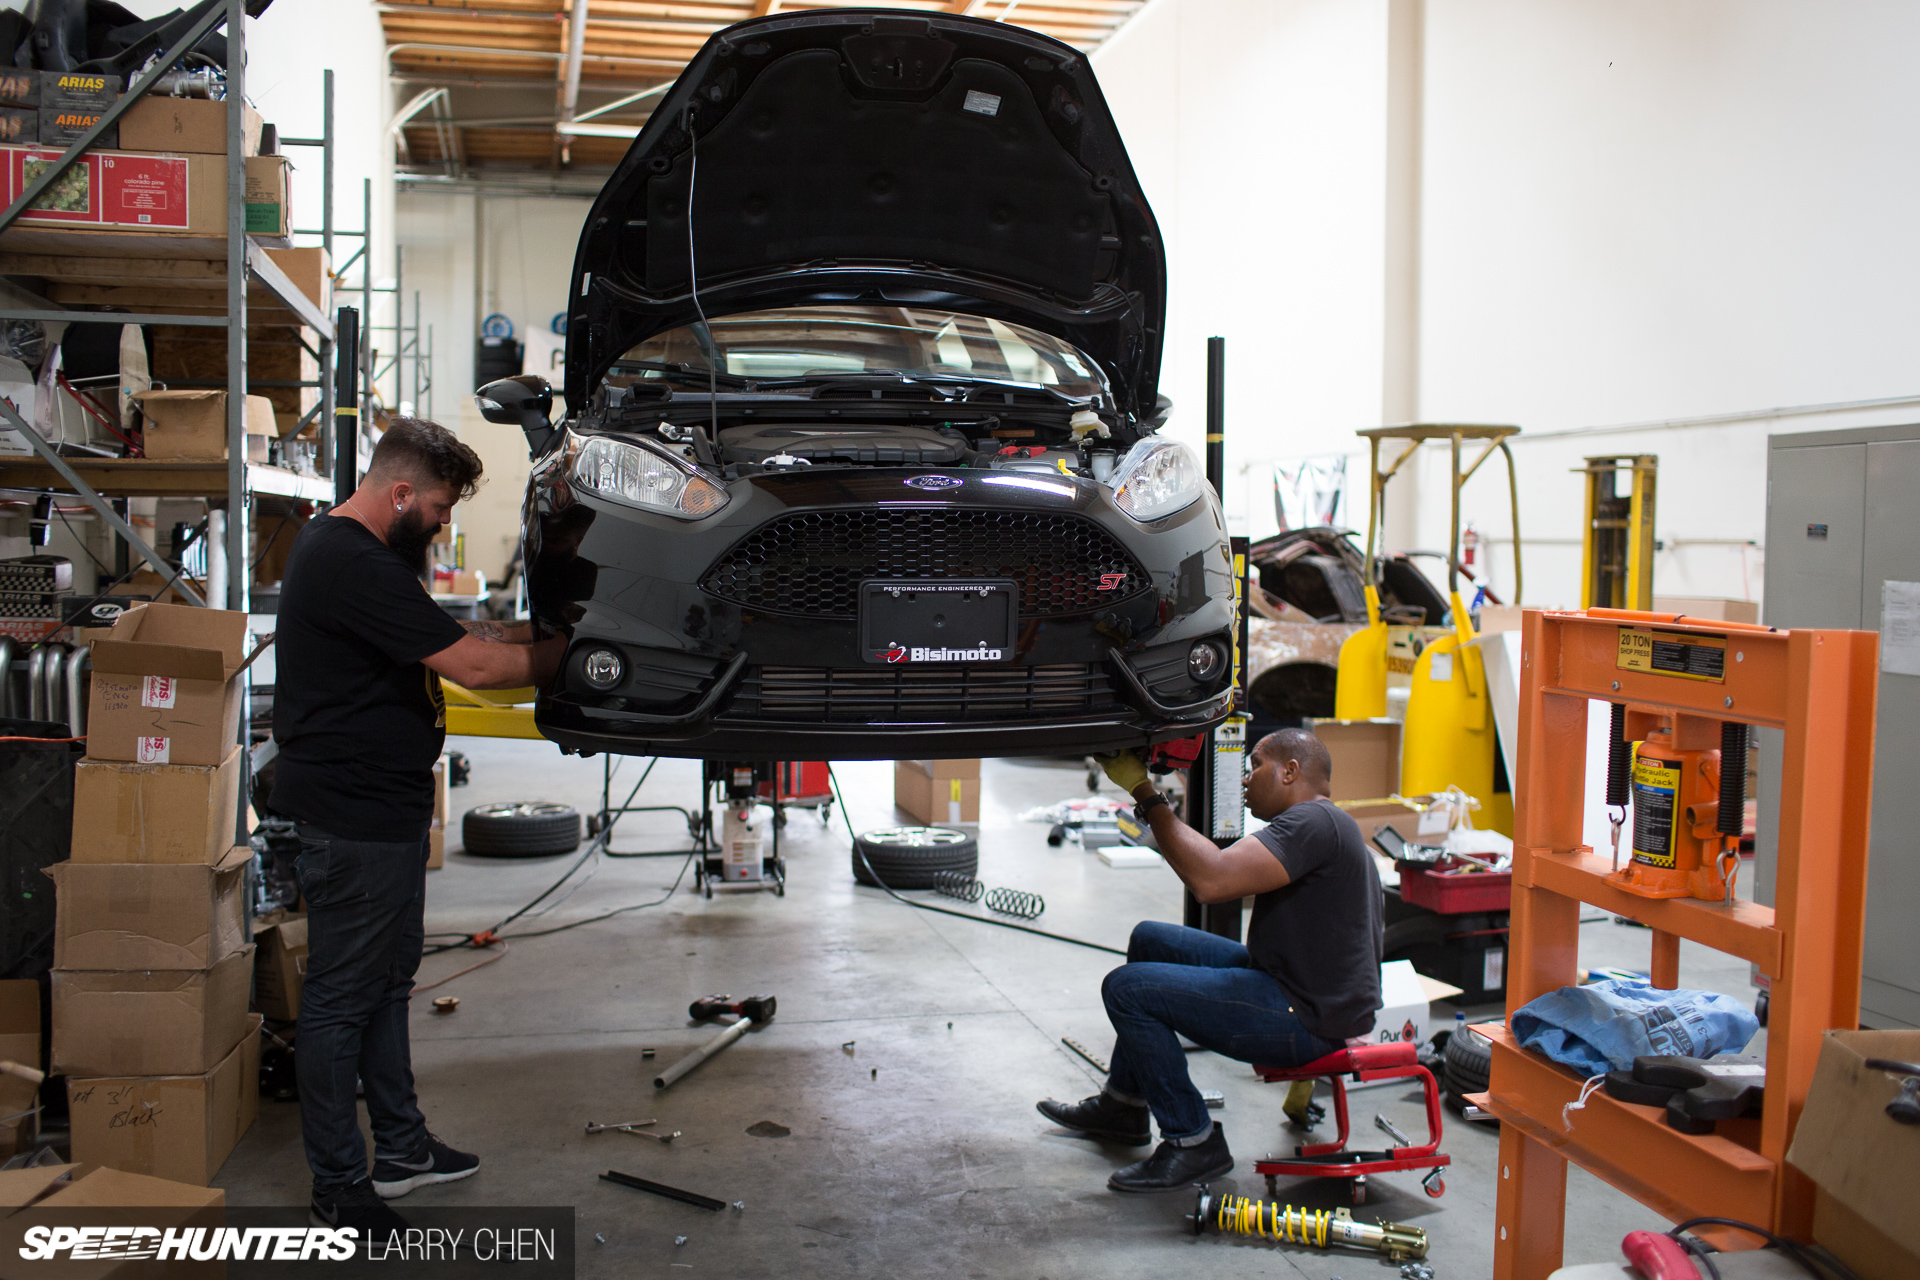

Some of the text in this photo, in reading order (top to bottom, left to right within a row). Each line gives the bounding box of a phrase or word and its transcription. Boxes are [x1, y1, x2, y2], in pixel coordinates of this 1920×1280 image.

[57, 76, 105, 89] ARIAS
[103, 159, 115, 168] 10
[918, 476, 951, 487] Ford
[0, 566, 45, 574] ARIAS
[1097, 573, 1127, 590] ST
[1621, 633, 1651, 648] 20 TON
[910, 647, 1002, 661] Bisimoto
[1620, 647, 1650, 657] SHOP PRESS
[108, 1105, 163, 1129] Black
